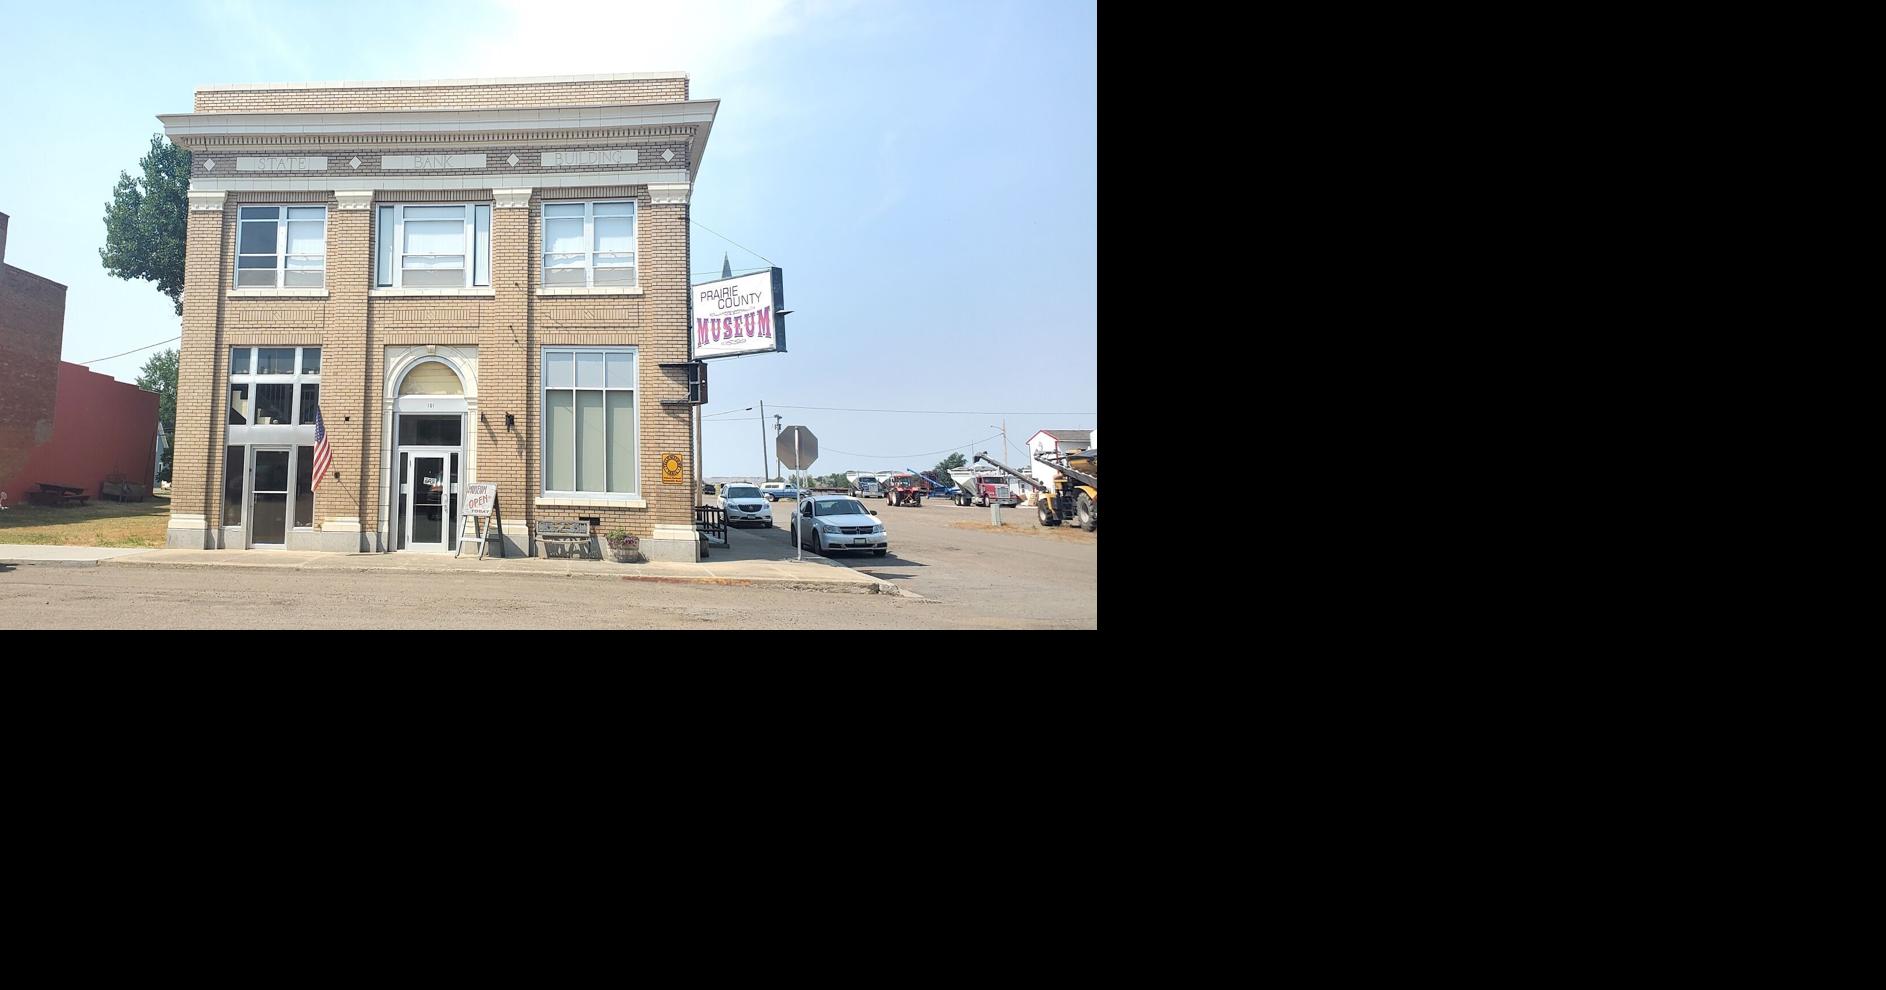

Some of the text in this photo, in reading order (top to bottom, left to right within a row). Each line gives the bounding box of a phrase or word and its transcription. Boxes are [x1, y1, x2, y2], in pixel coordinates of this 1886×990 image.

[258, 157, 306, 170] STATE
[415, 154, 454, 169] BANK
[555, 150, 622, 167] BUILDING
[700, 285, 738, 302] PRAIRIE
[717, 291, 762, 310] COUNTY
[696, 305, 772, 348] MUSEUM
[468, 494, 488, 509] OPEN
